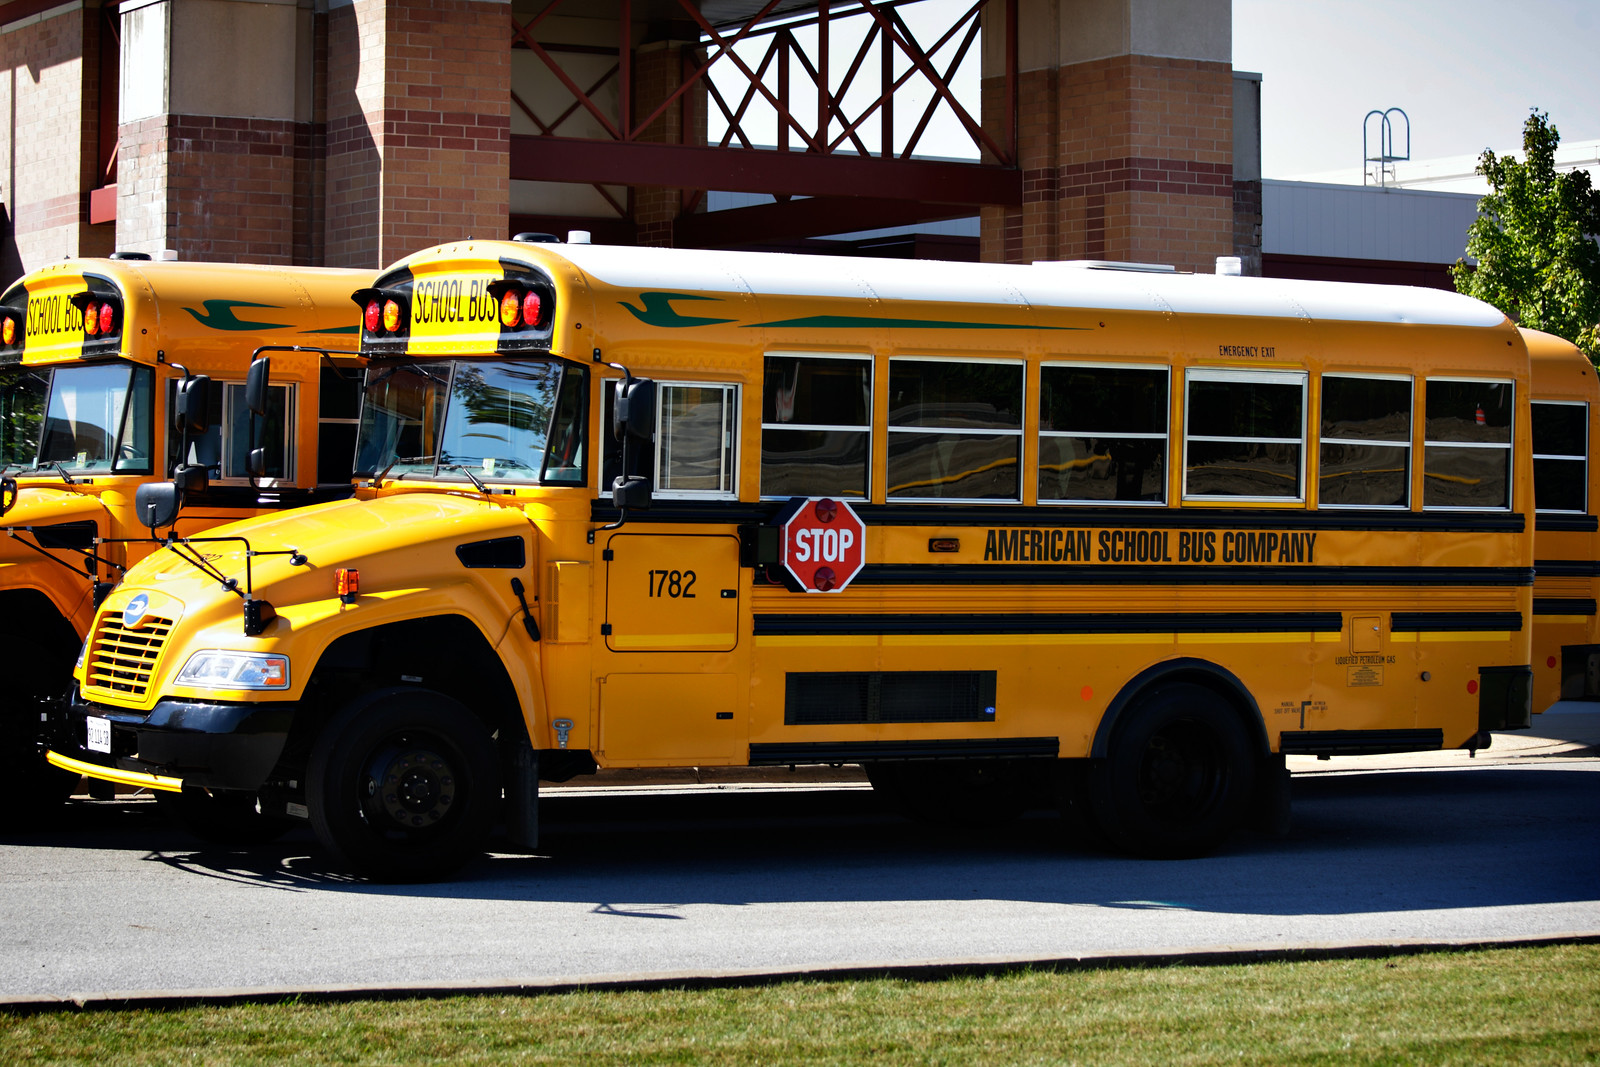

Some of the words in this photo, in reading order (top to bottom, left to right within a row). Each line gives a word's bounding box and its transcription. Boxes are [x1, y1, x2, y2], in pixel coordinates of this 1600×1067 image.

[27, 295, 61, 336] SCHOOL
[415, 279, 464, 323] SCHOOL
[469, 278, 497, 322] BUS
[1219, 345, 1258, 357] EMERGENCY
[1261, 347, 1275, 358] EXIT
[795, 528, 854, 562] STOP
[984, 529, 1091, 562] AMERICAN
[1098, 530, 1171, 562] SCHOOL
[1179, 530, 1216, 562] BUS
[1222, 531, 1316, 563] COMPANY
[648, 569, 697, 598] 1782
[1335, 656, 1358, 665] LIQUEFIED
[1360, 655, 1385, 664] PETROLEUM
[1386, 655, 1396, 664] GAS
